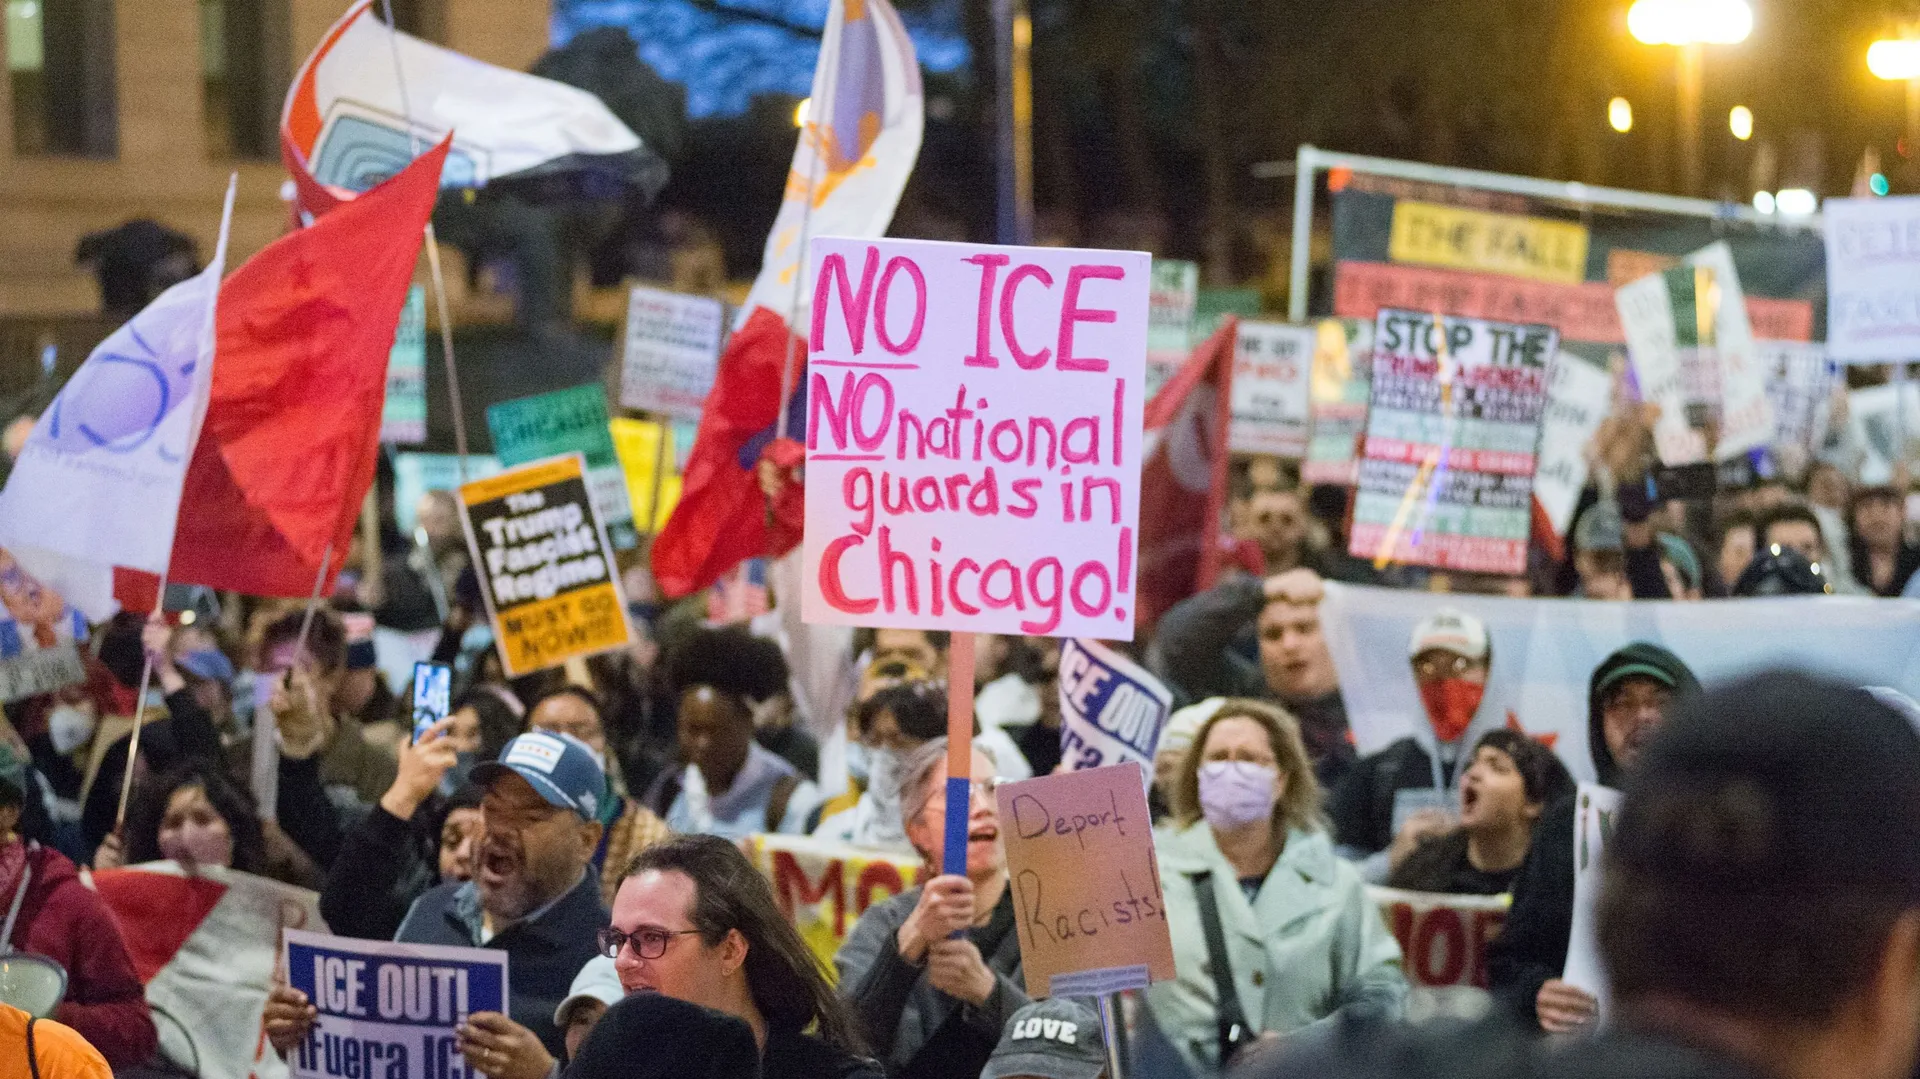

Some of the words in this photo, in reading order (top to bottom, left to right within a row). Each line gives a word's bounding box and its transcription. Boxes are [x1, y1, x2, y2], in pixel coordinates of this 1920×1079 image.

[810, 246, 927, 356] NO
[961, 253, 1125, 373] ICE
[1384, 315, 1473, 357] STOP
[1486, 328, 1549, 367] THE
[807, 370, 895, 452] NO
[897, 378, 1125, 470] national
[482, 502, 583, 546] Trump
[504, 490, 545, 515] The
[843, 466, 1043, 536] guards
[1061, 464, 1121, 525] in
[486, 523, 598, 577] Fascist
[493, 555, 606, 605] Regime
[818, 526, 1132, 635] Chicago!
[506, 601, 570, 637] MUST
[579, 593, 614, 614] GO
[1012, 787, 1125, 851] Deport
[1017, 847, 1166, 950] Racists!
[313, 954, 367, 1017] ICE
[377, 963, 469, 1024] OUT!
[1012, 1017, 1078, 1046] LOVE
